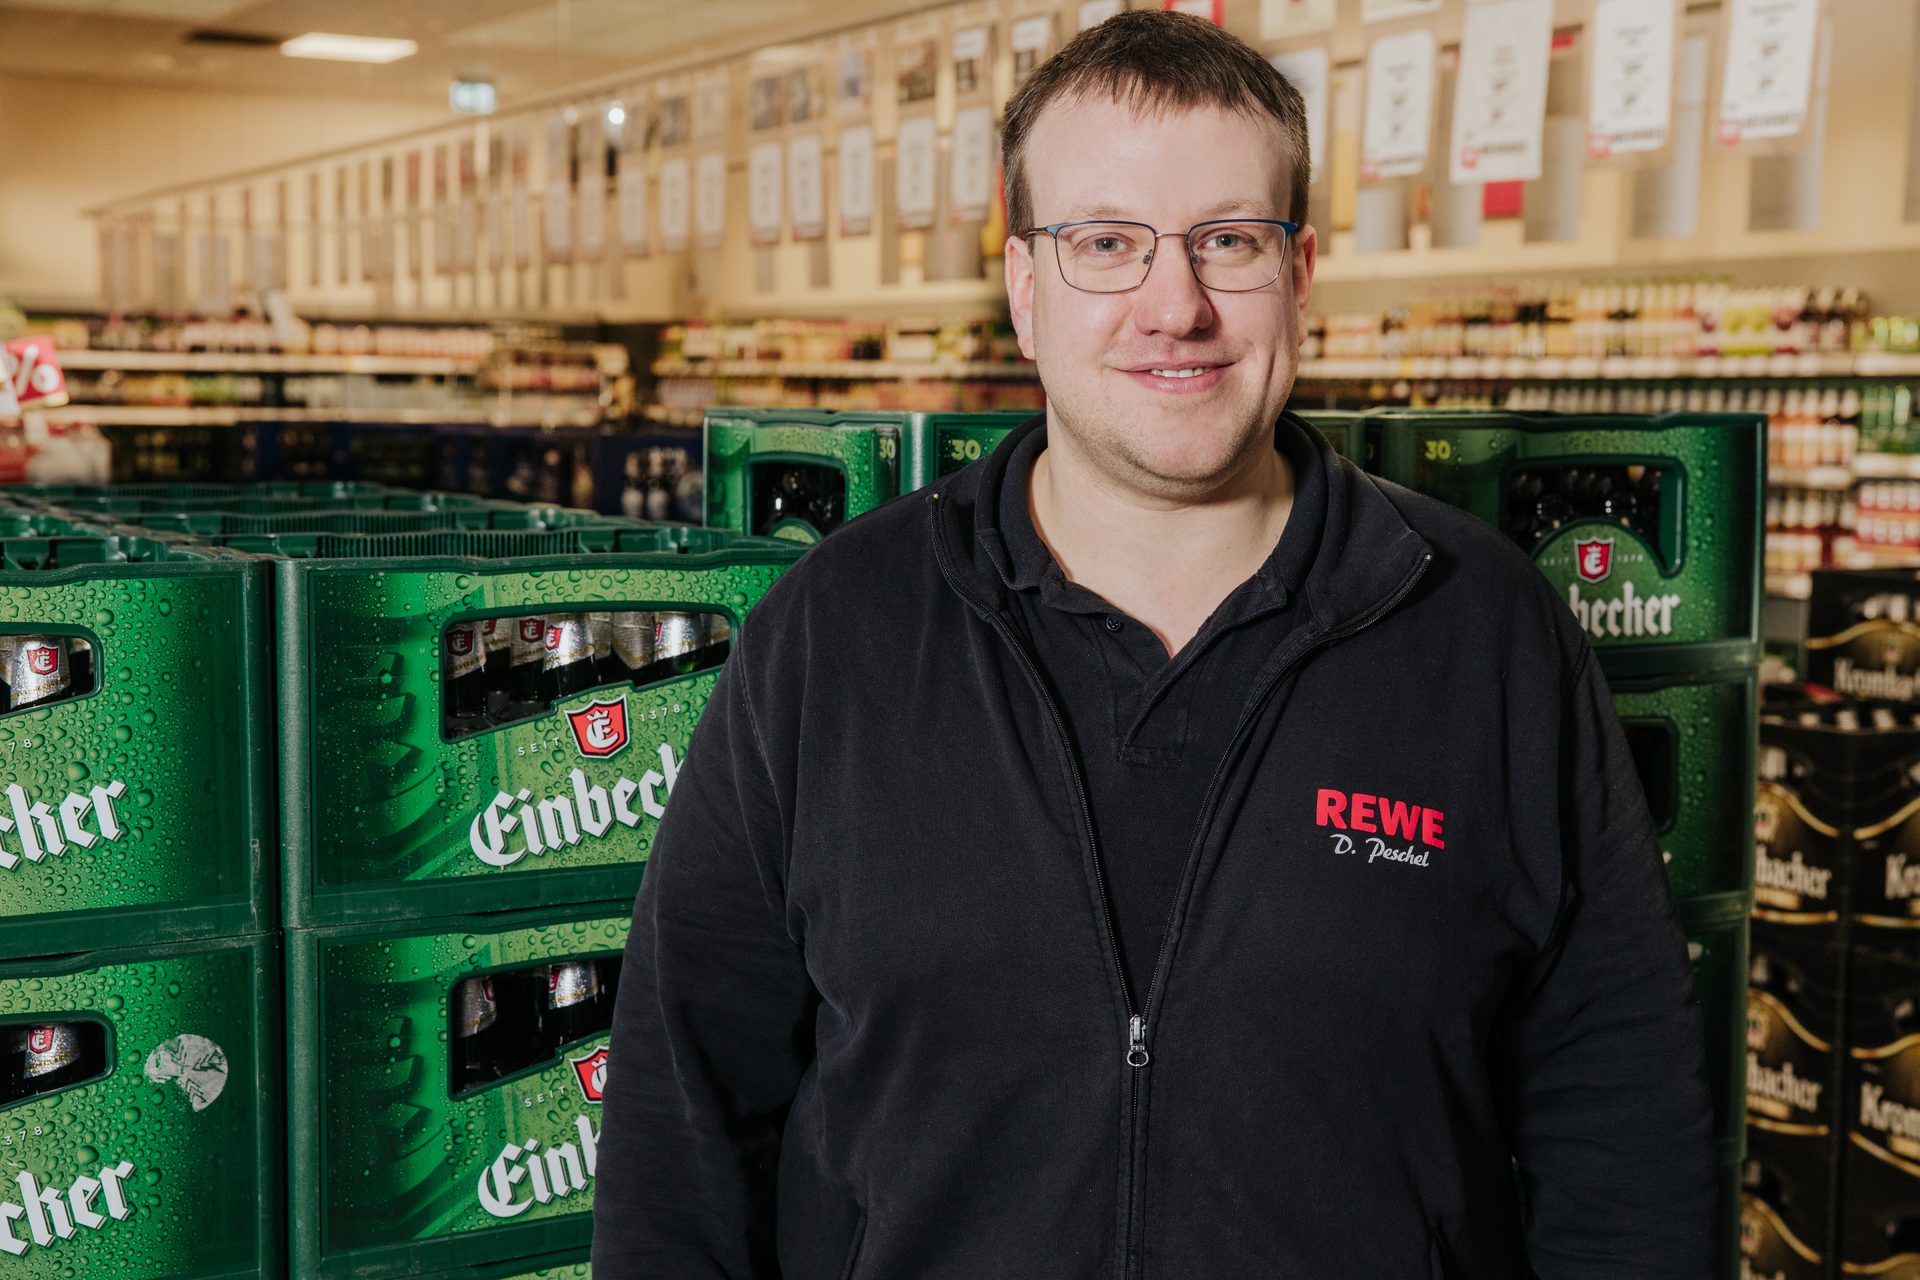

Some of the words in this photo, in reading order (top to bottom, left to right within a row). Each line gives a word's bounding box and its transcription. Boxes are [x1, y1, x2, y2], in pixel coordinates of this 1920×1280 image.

[880, 439, 895, 459] 30
[951, 439, 981, 460] 30
[1425, 440, 1450, 460] 30
[517, 737, 561, 756] SEIT
[640, 703, 681, 722] 1378
[1316, 788, 1445, 850] REWE
[1330, 833, 1357, 855] D.
[1365, 837, 1430, 867] Peschel
[524, 1085, 565, 1108] SEIT
